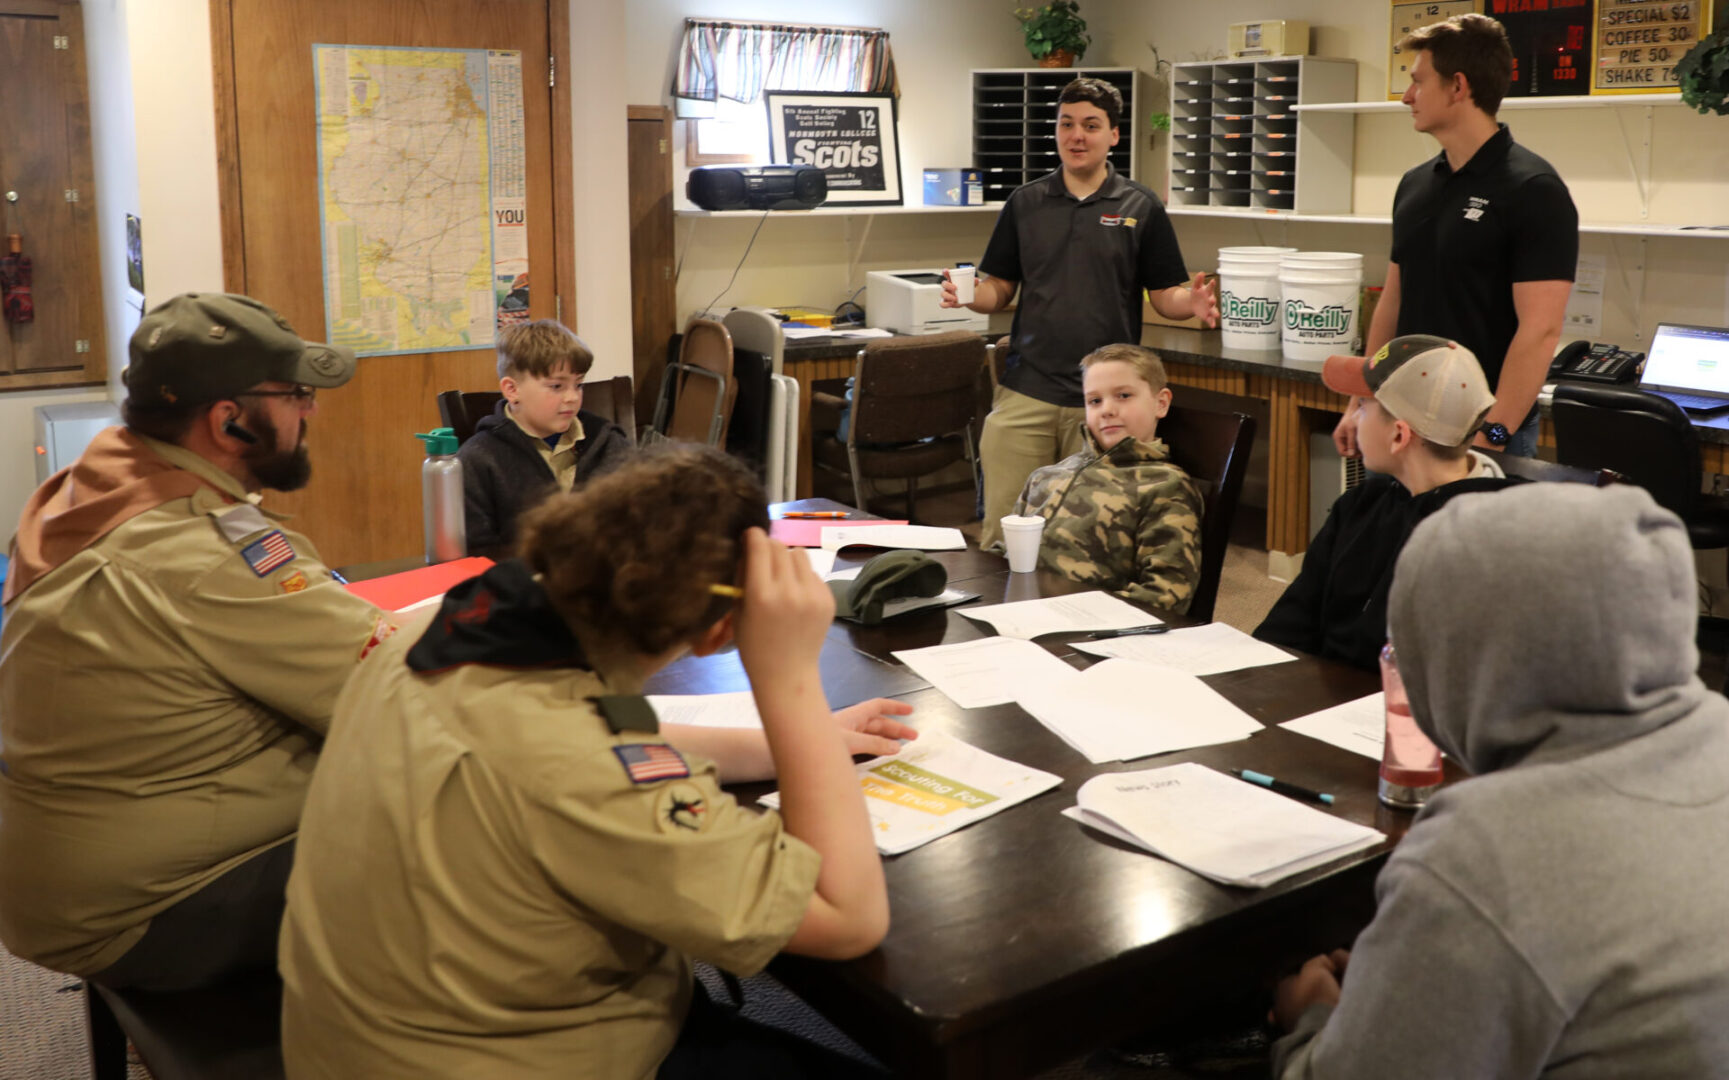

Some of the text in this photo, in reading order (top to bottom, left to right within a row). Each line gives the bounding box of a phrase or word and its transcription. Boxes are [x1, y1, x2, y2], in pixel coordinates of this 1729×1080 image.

[1427, 5, 1439, 15] 12
[1608, 5, 1690, 25] SPECIAL $2
[1605, 28, 1660, 46] COFFEE
[1619, 49, 1642, 64] PIE
[1606, 68, 1654, 83] SHAKE
[858, 110, 877, 129] 12
[788, 130, 838, 138] MONMOUTH
[792, 138, 879, 169] Scots
[495, 209, 524, 223] YOU
[1286, 301, 1350, 331] O'Reilly
[881, 764, 985, 804] Scouting For
[897, 792, 948, 812] Truth
